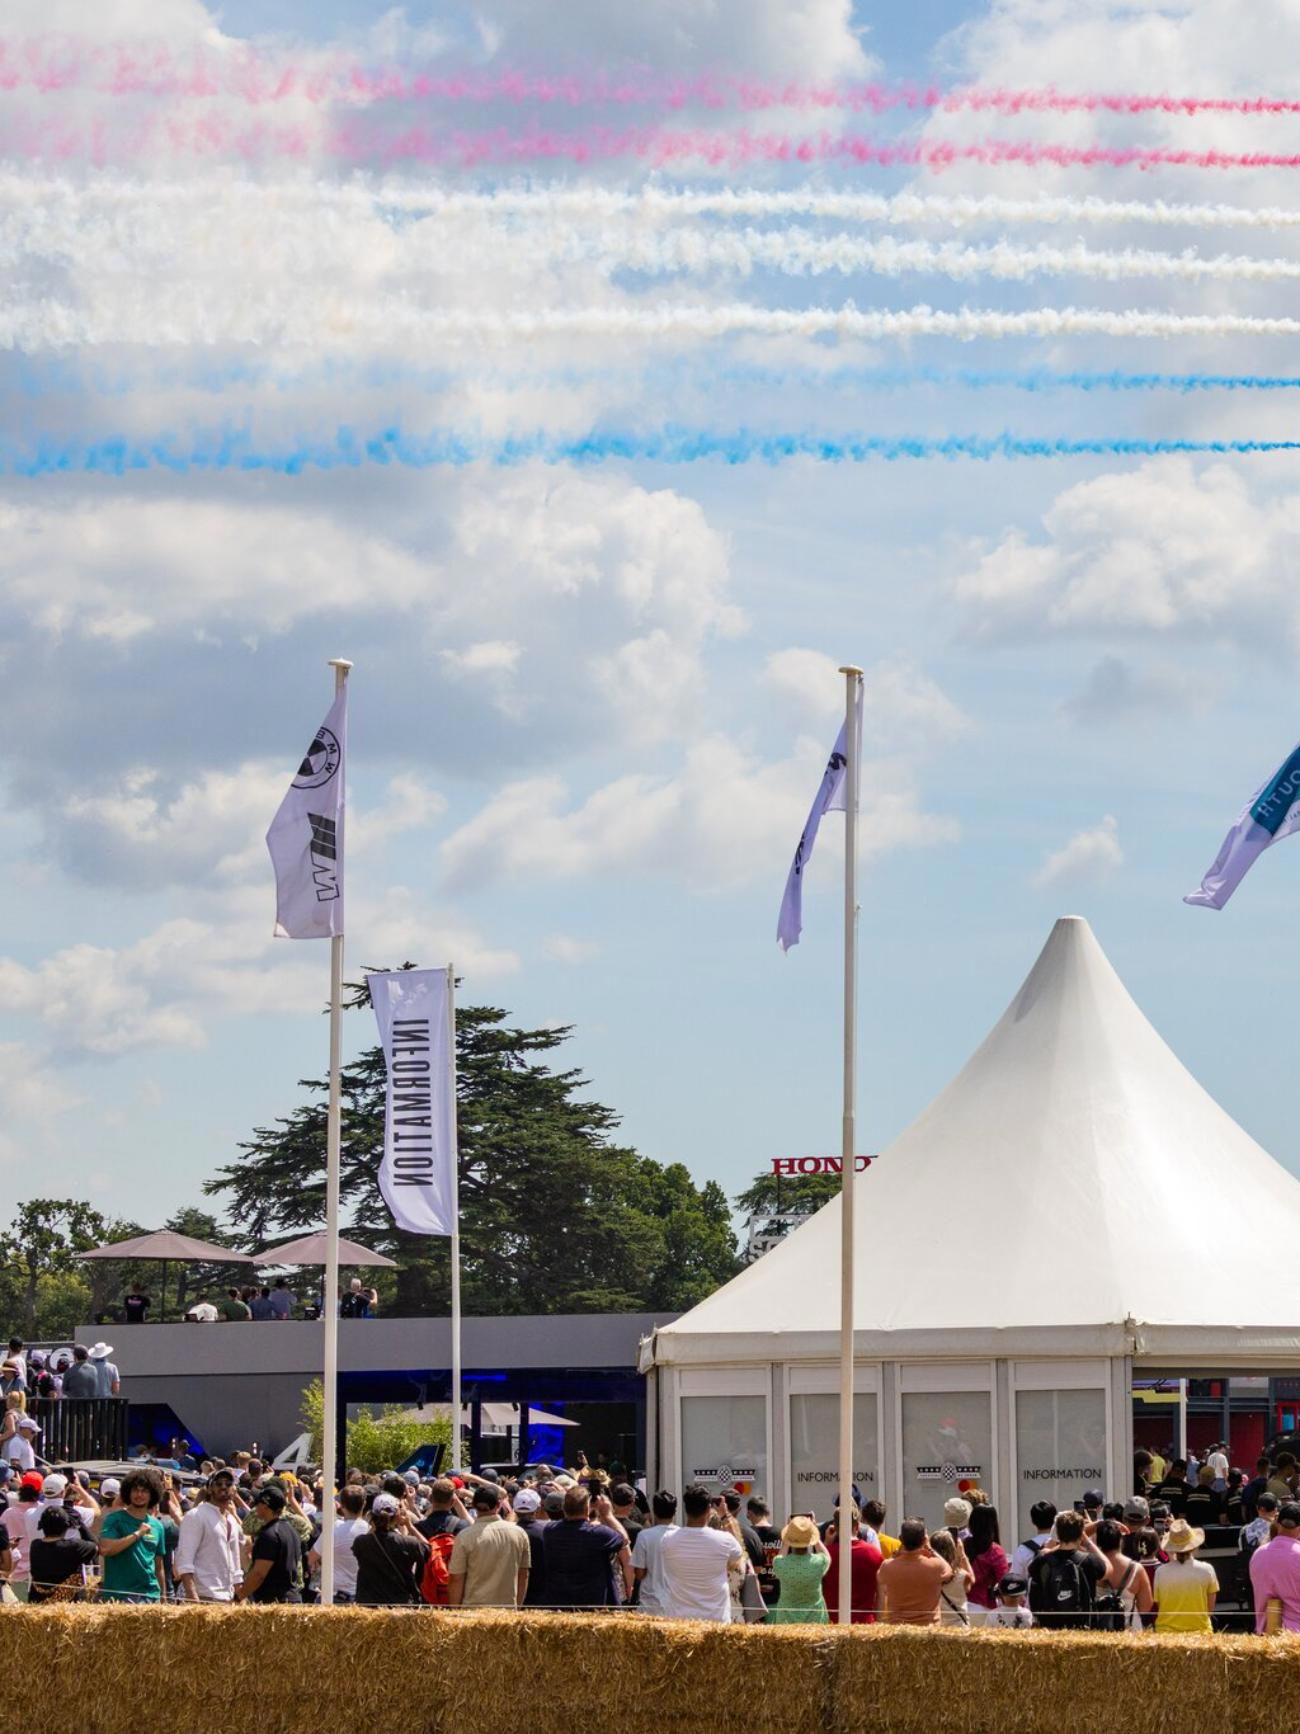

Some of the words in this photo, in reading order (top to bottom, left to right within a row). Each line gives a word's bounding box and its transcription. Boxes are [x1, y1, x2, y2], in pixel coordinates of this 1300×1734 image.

[771, 1155, 873, 1175] HOND
[797, 1471, 874, 1482] INFORMION
[1023, 1468, 1102, 1480] INFORMATION
